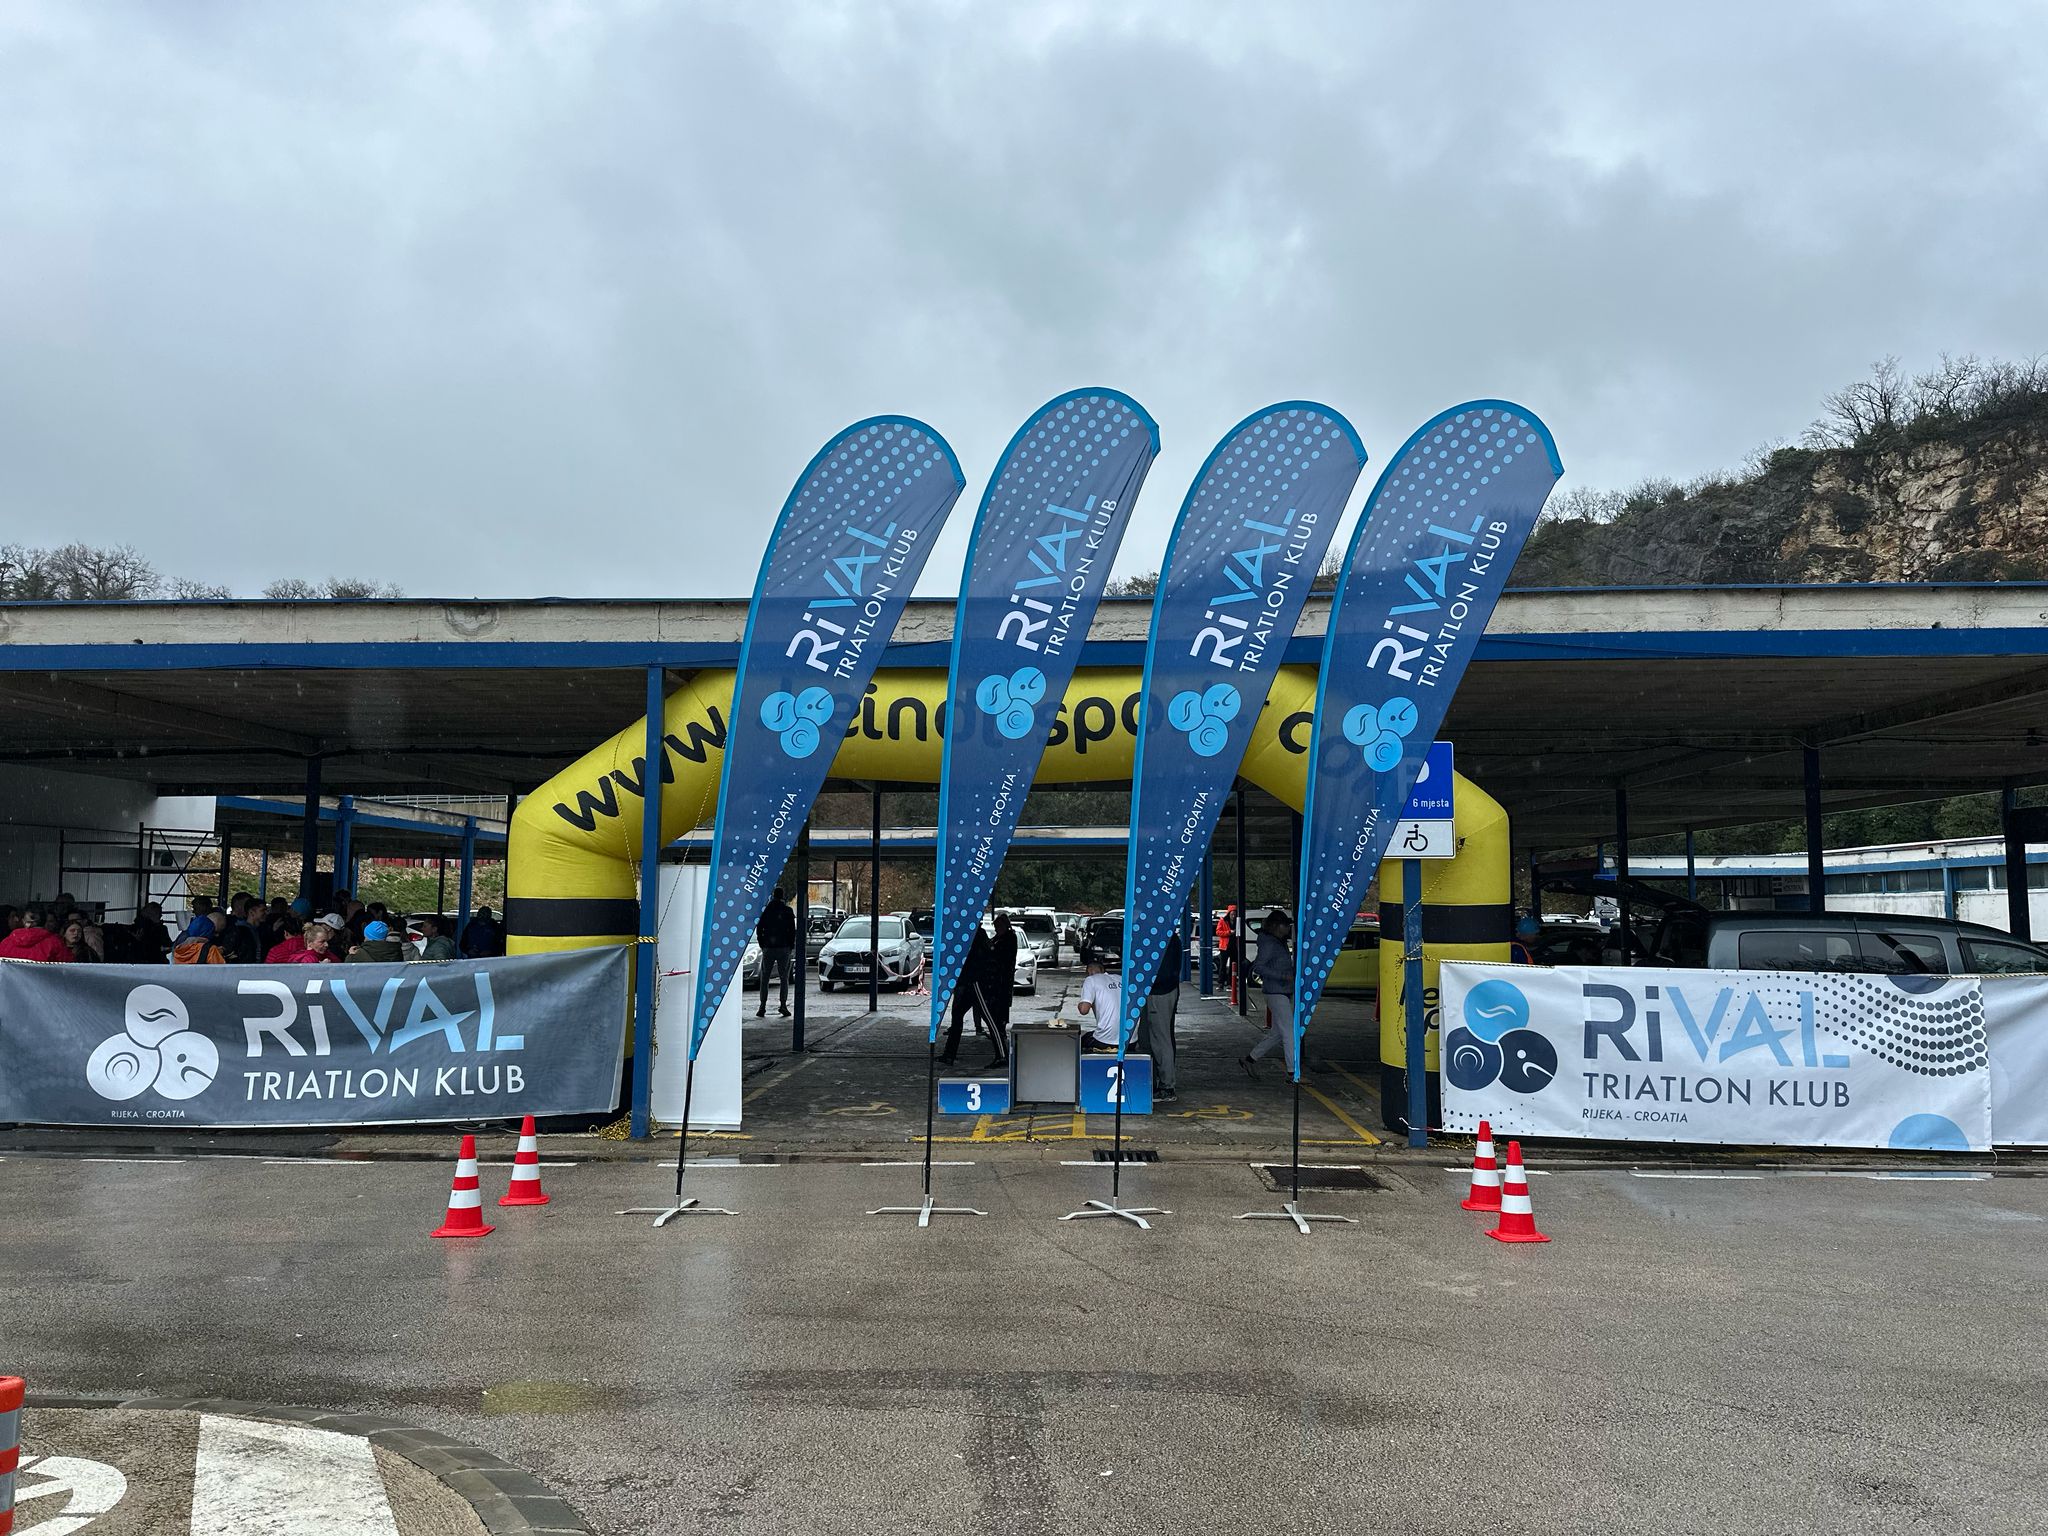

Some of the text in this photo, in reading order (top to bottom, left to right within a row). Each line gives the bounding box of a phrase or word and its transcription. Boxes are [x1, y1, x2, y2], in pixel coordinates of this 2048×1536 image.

[834, 527, 918, 679] TRIATLON KLUB
[1044, 498, 1117, 656] TRIATLON KLUB
[1239, 512, 1318, 672] TRIATLON KLUB
[1418, 520, 1507, 687] TRIATLON KLUB
[743, 854, 769, 893] RIJEKA
[767, 793, 797, 844] CROATIA
[971, 837, 993, 876] RIJEKA
[990, 774, 1016, 826] CROATIA
[1161, 855, 1184, 894] RIJEKA
[1181, 792, 1208, 844] CROATIA
[1412, 798, 1449, 809] 6 mjesta
[1332, 872, 1354, 911] RIJEKA
[1352, 808, 1380, 860] CROATIA
[111, 1110, 139, 1119] RIJEKA
[146, 1109, 186, 1119] CROATIA
[243, 1065, 526, 1101] TRIATLON KLUB
[966, 1083, 981, 1111] 3
[1106, 1066, 1125, 1103] 2
[1582, 1072, 1850, 1108] TRIATLON KLUB
[1582, 1108, 1622, 1121] RIJEKA
[1634, 1110, 1689, 1124] CROATIA
